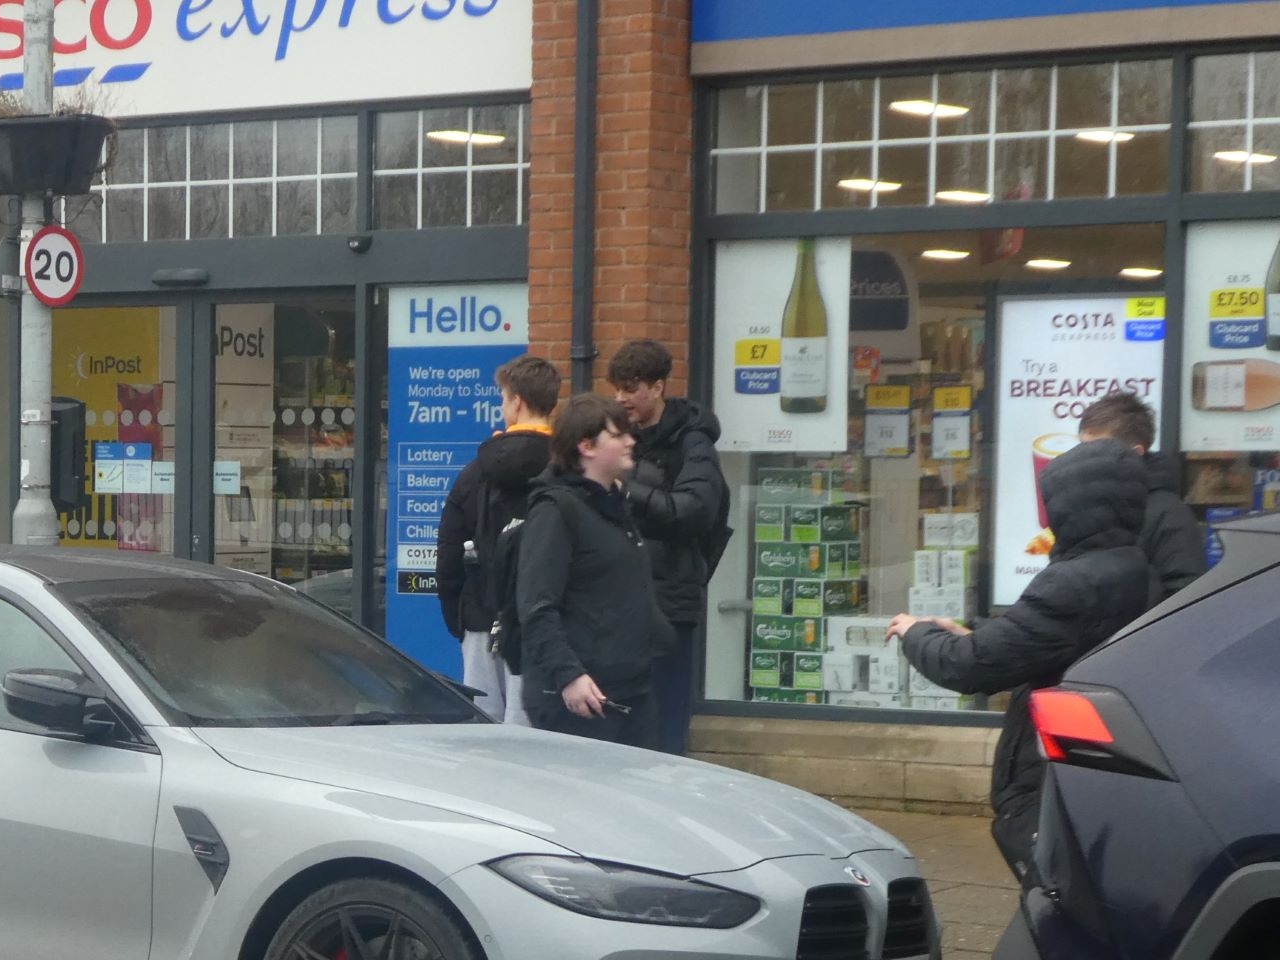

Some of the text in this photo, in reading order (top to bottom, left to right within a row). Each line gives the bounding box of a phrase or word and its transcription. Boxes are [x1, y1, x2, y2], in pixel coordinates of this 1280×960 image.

[35, 249, 74, 282] 20
[1217, 291, 1259, 306] £7.50
[409, 296, 511, 333] Hello.
[1051, 313, 1115, 330] COSTA
[1216, 322, 1259, 333] Clubcard
[1224, 334, 1250, 344] Price
[751, 344, 768, 360] £7
[89, 355, 142, 374] InPost
[1023, 359, 1058, 376] Try a
[409, 367, 480, 382] We're open
[740, 371, 777, 380] Clubcard
[408, 384, 455, 400] Monday
[458, 385, 471, 397] to
[748, 381, 769, 390] Price
[1010, 377, 1156, 398] BREAKFAST
[408, 401, 451, 423] 7am
[407, 448, 453, 465] Lottery
[407, 474, 450, 490] Bakery
[406, 499, 438, 512] Food
[407, 549, 438, 558] COSTA
[761, 551, 796, 567] Carlsberg
[756, 624, 791, 640] Carlsberg
